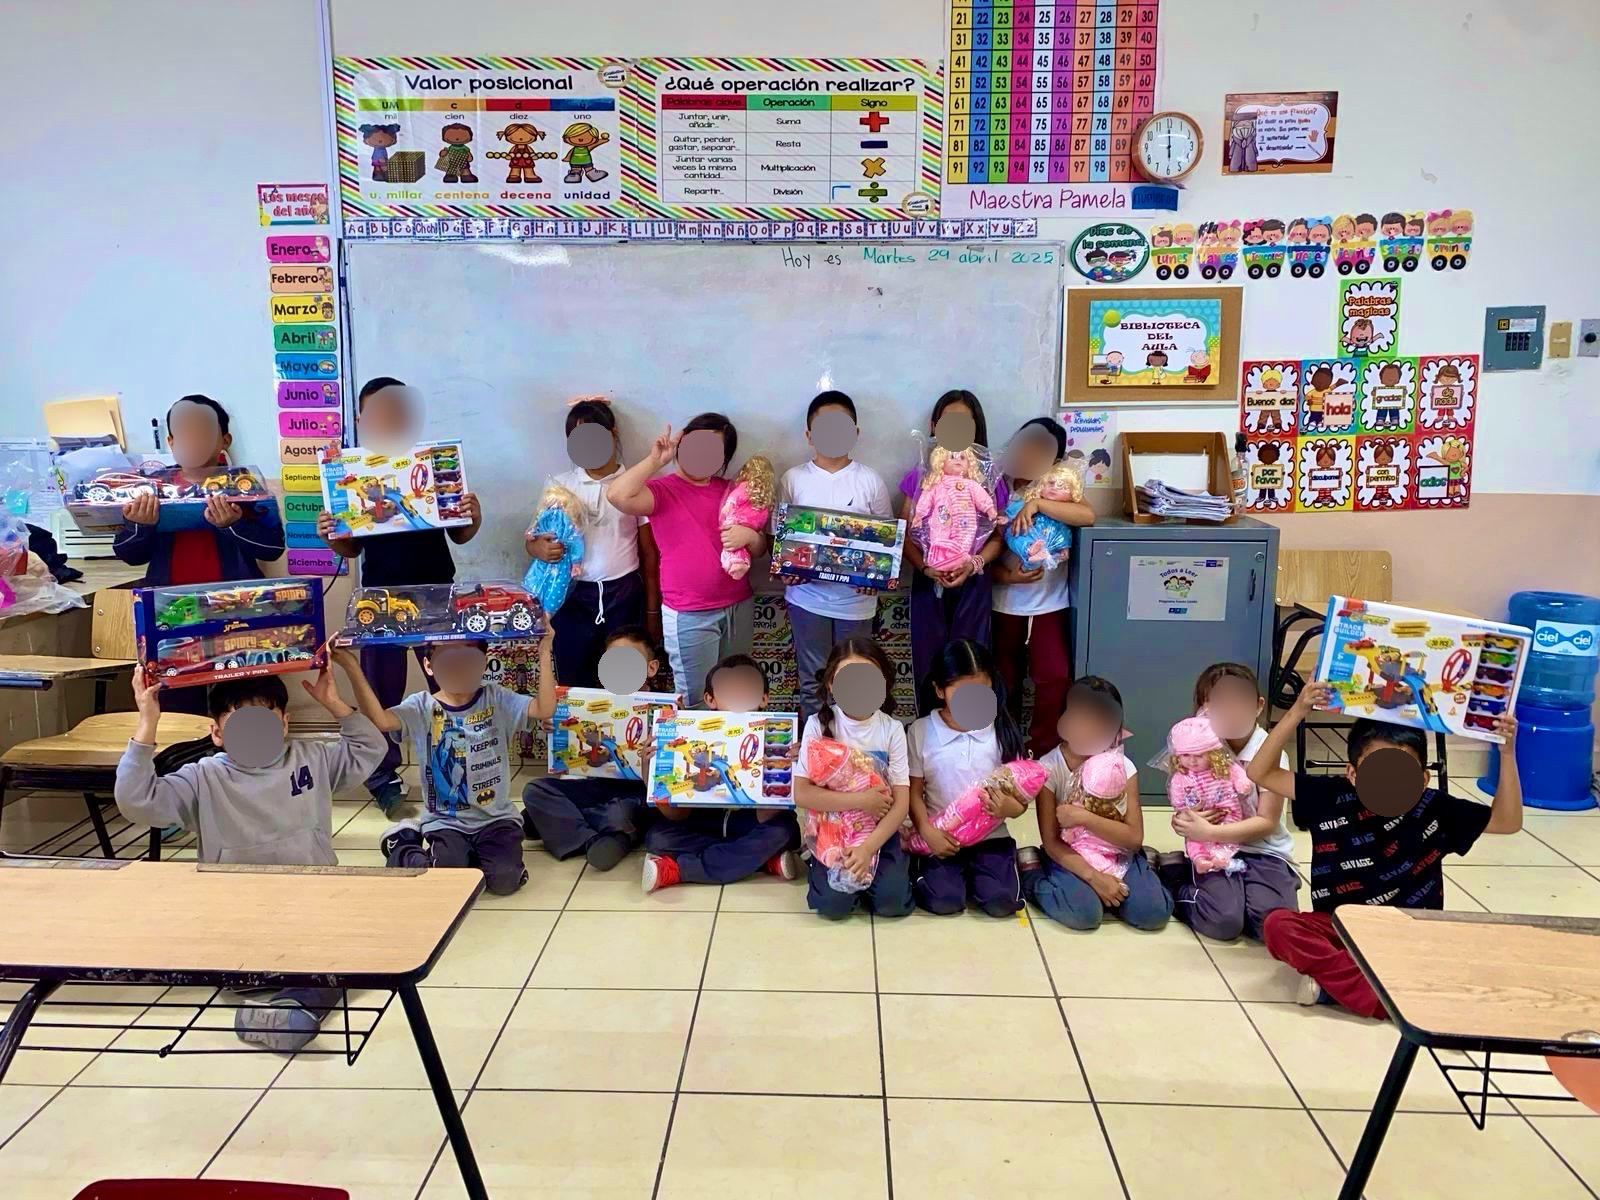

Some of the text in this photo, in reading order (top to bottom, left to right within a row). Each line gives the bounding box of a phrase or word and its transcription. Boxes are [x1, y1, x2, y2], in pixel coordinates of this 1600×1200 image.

[956, 10, 1153, 24] 21 22 23 24 25 26 27 28 29 30
[404, 75, 573, 93] Valor posicional
[665, 76, 915, 93] ¿Qué operación realizar?
[382, 101, 399, 110] UM
[763, 98, 815, 108] Operación
[861, 99, 887, 108] Signo
[954, 96, 1149, 109] 61 62 63 64 65 66 67 68 69 70
[509, 112, 528, 120] diez
[678, 113, 730, 121] Juntar, unir,
[1155, 122, 1161, 132] 11
[1180, 121, 1183, 131] 1
[673, 135, 735, 144] Quitar, perder,
[1147, 131, 1153, 141] 10
[668, 144, 699, 153] gastar,
[1144, 142, 1149, 153] 9
[1189, 142, 1194, 151] 3
[1147, 154, 1151, 164] 8
[761, 163, 816, 172] Multiplicación
[953, 160, 1126, 173] 91 92 93 94 95 96 97 98 99
[1155, 163, 1159, 173] 7
[1166, 165, 1171, 175] 6
[1177, 162, 1182, 172] 5
[386, 190, 423, 200] millar
[435, 190, 489, 200] centena
[500, 190, 551, 200] decena
[564, 191, 611, 200] unidad
[773, 187, 803, 196] División
[263, 192, 325, 203] Los meses
[969, 190, 1052, 210] Maestra
[1060, 188, 1125, 209] Pamela
[273, 204, 317, 217] del año
[1117, 226, 1133, 235] de
[271, 243, 311, 256] Enero
[1082, 239, 1146, 250] la semana
[781, 247, 1053, 270] Hoy es Martes 29 abril 2025
[1157, 253, 1187, 265] Lunes
[271, 273, 318, 283] Febrero
[1348, 296, 1393, 306] Palabras
[274, 303, 318, 316] Marzo
[1120, 321, 1201, 330] BIBLIOTECA
[280, 332, 316, 344] Abril
[1141, 343, 1178, 351] AULA
[280, 360, 319, 374] Mayo
[284, 388, 319, 401] Junio
[1442, 387, 1454, 397] de
[1247, 398, 1276, 406] Buenos
[1435, 397, 1457, 405] nada
[1326, 403, 1351, 416] hola
[288, 419, 318, 430] Julio
[285, 474, 320, 482] Septiembr
[1256, 476, 1280, 485] favor
[286, 503, 324, 512] Octubr
[288, 558, 333, 567] Diciembre
[819, 572, 836, 581] TRAILER
[840, 575, 850, 583] PIPA
[1160, 568, 1178, 578] Todos
[1185, 568, 1198, 578] Leer
[1536, 631, 1559, 643] ciel
[1573, 634, 1591, 645] ciel
[213, 672, 245, 680] TRAILER
[471, 756, 501, 771] CRIMINALS
[290, 765, 314, 797] 14
[472, 775, 501, 792] STREETS
[1319, 817, 1349, 831] SAVAGE
[1340, 858, 1374, 870] SAVAGE
